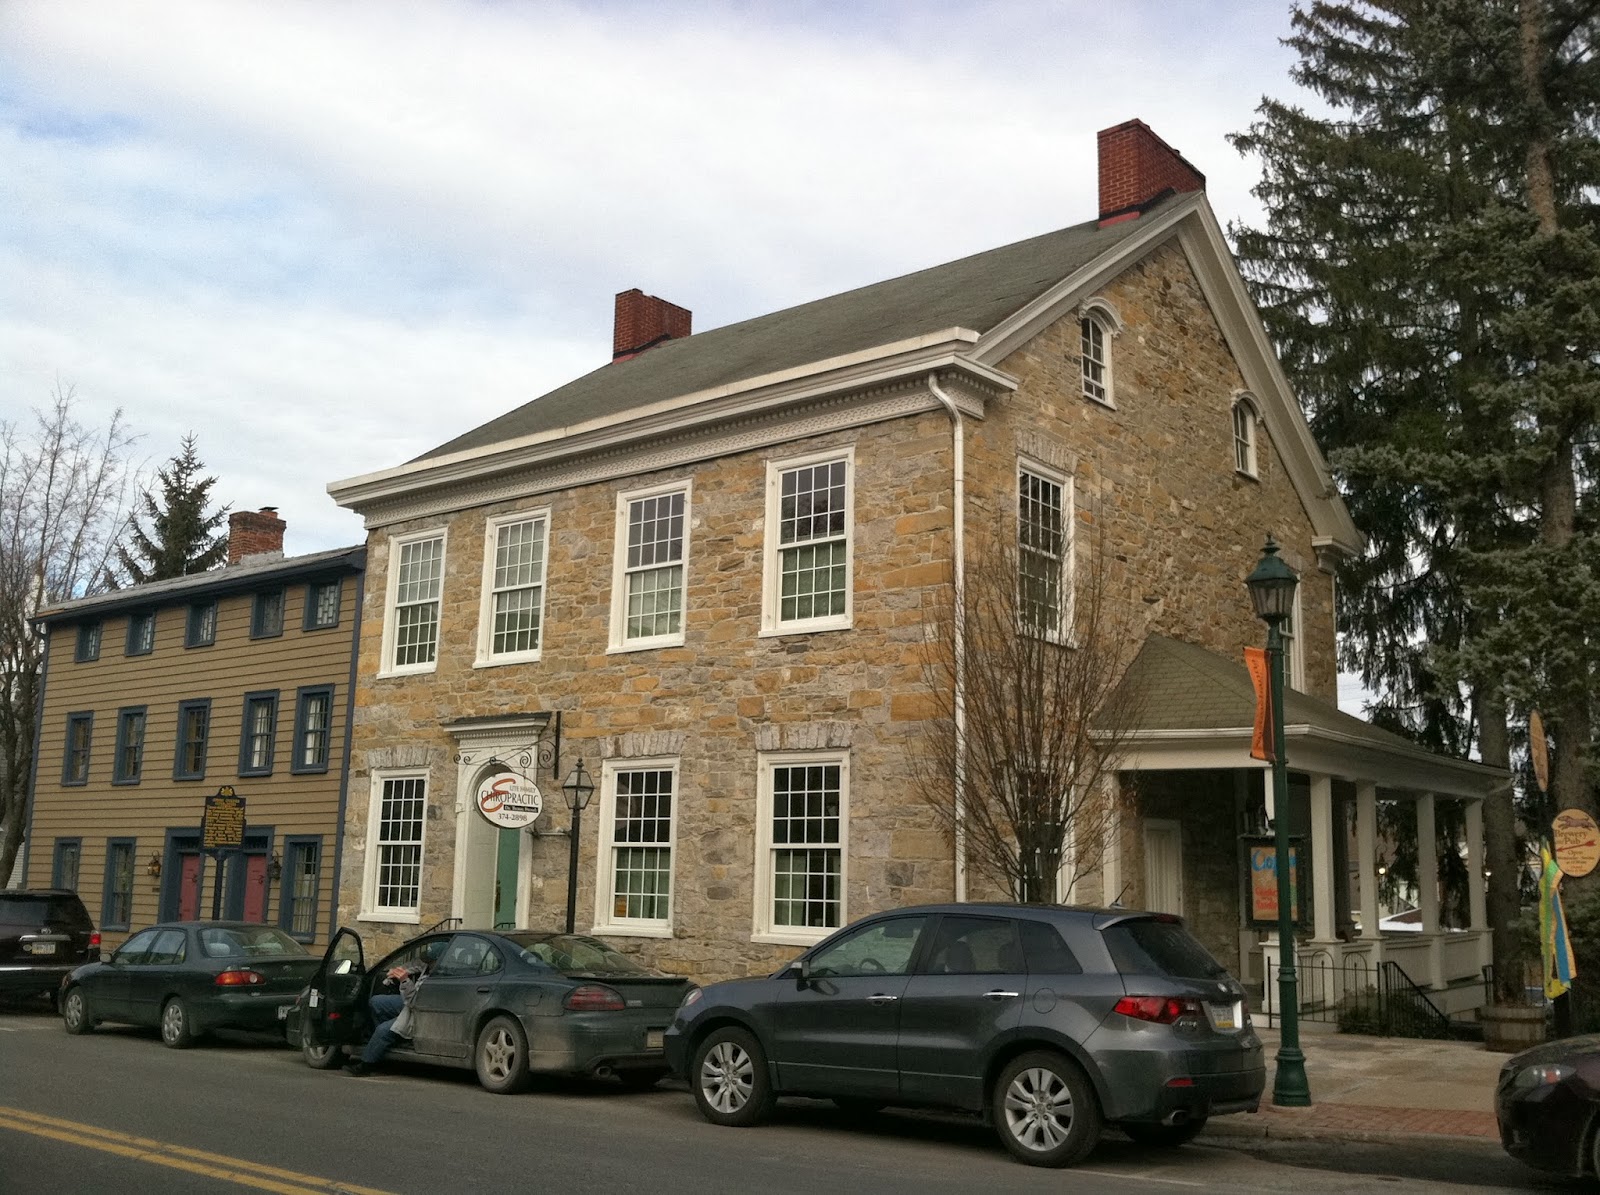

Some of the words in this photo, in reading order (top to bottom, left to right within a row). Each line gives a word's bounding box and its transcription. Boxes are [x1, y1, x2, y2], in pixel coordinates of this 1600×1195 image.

[481, 790, 539, 805] CHIROPRACTIC
[1555, 830, 1587, 839] Brewery
[1564, 837, 1581, 845] Pub
